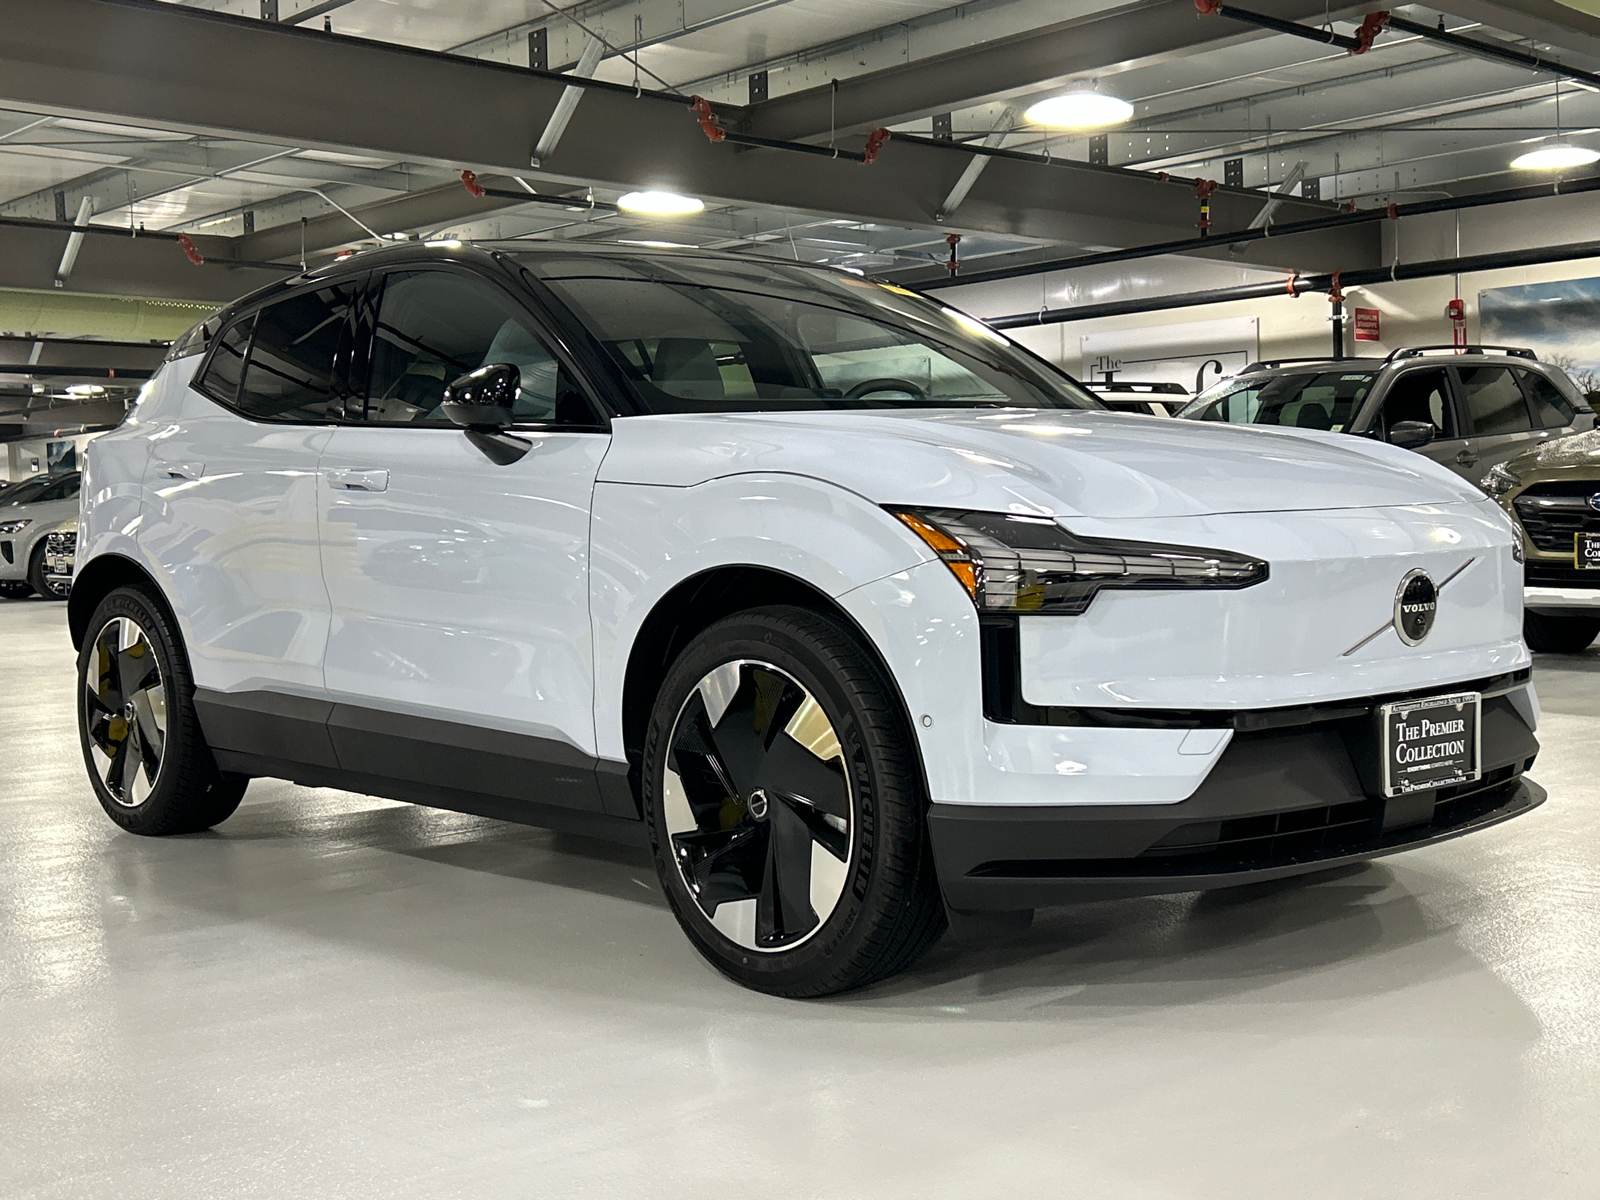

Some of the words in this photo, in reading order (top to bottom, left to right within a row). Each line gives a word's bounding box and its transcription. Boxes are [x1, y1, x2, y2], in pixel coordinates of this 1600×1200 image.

[1096, 355, 1122, 370] The
[1403, 602, 1435, 613] VOLVO
[1396, 722, 1419, 742] THE
[1421, 719, 1465, 738] PREMIER
[1396, 740, 1465, 763] COLLECTION
[854, 762, 875, 896] MICHELIN
